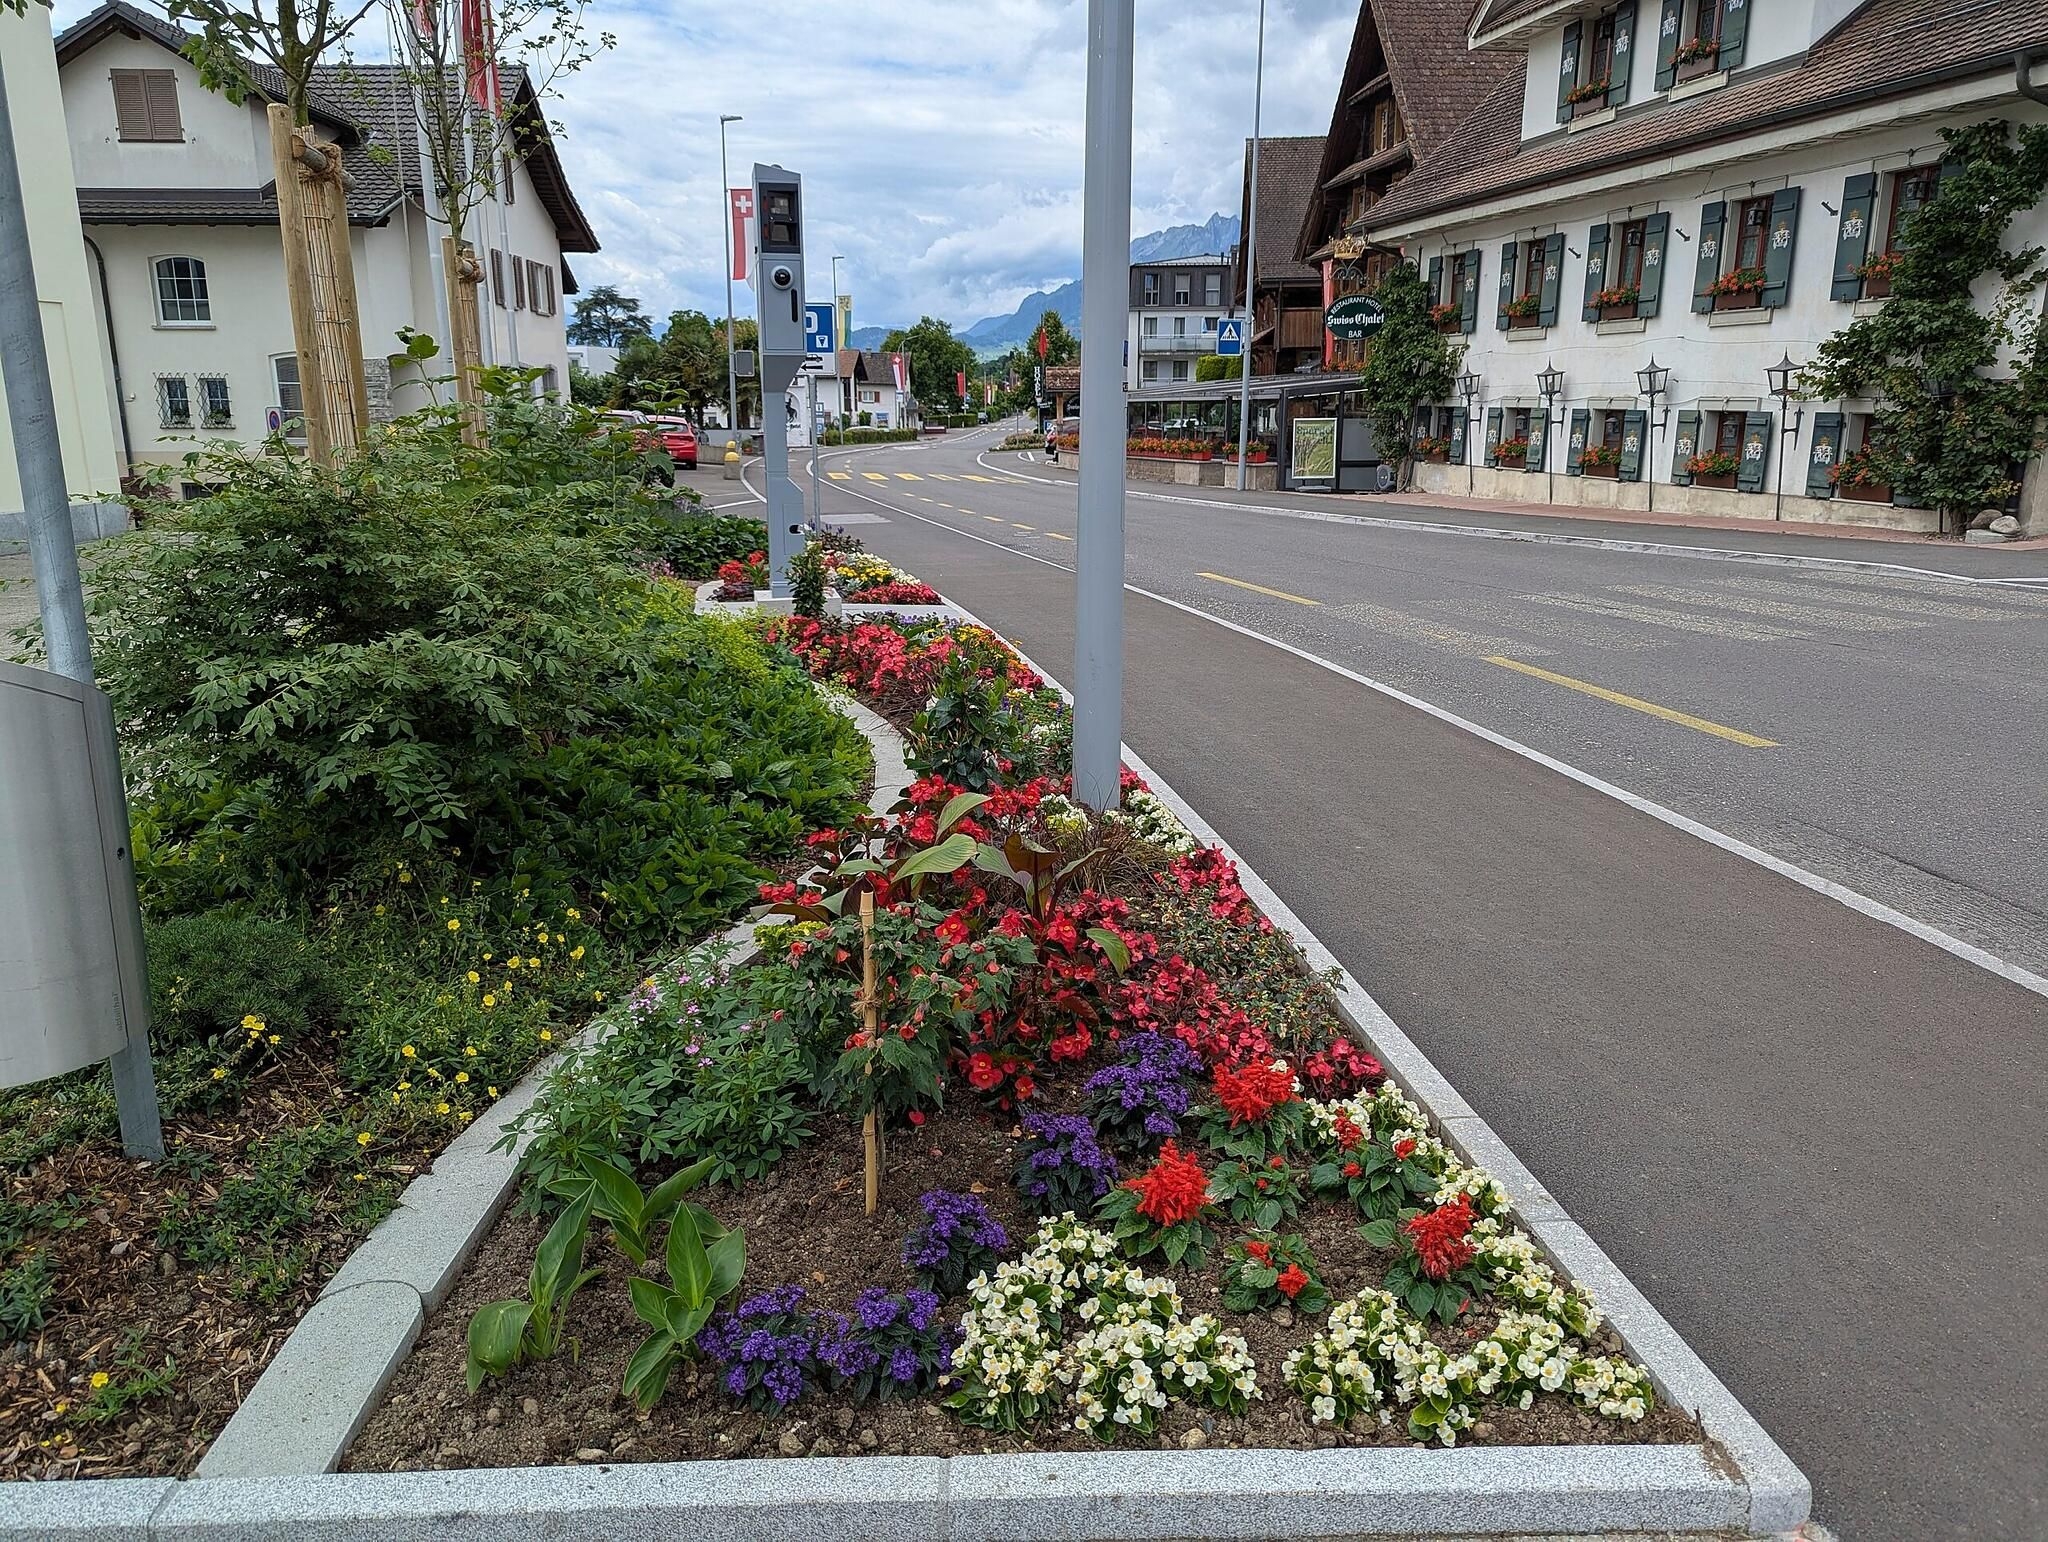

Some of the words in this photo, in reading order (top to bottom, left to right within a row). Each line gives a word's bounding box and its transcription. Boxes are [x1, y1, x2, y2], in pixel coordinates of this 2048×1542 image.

[1330, 296, 1365, 315] RESTAURANT
[1365, 298, 1383, 313] HOTEL
[1327, 314, 1354, 327] Swiss
[1355, 312, 1385, 326] Chalet
[1348, 330, 1362, 338] BAR
